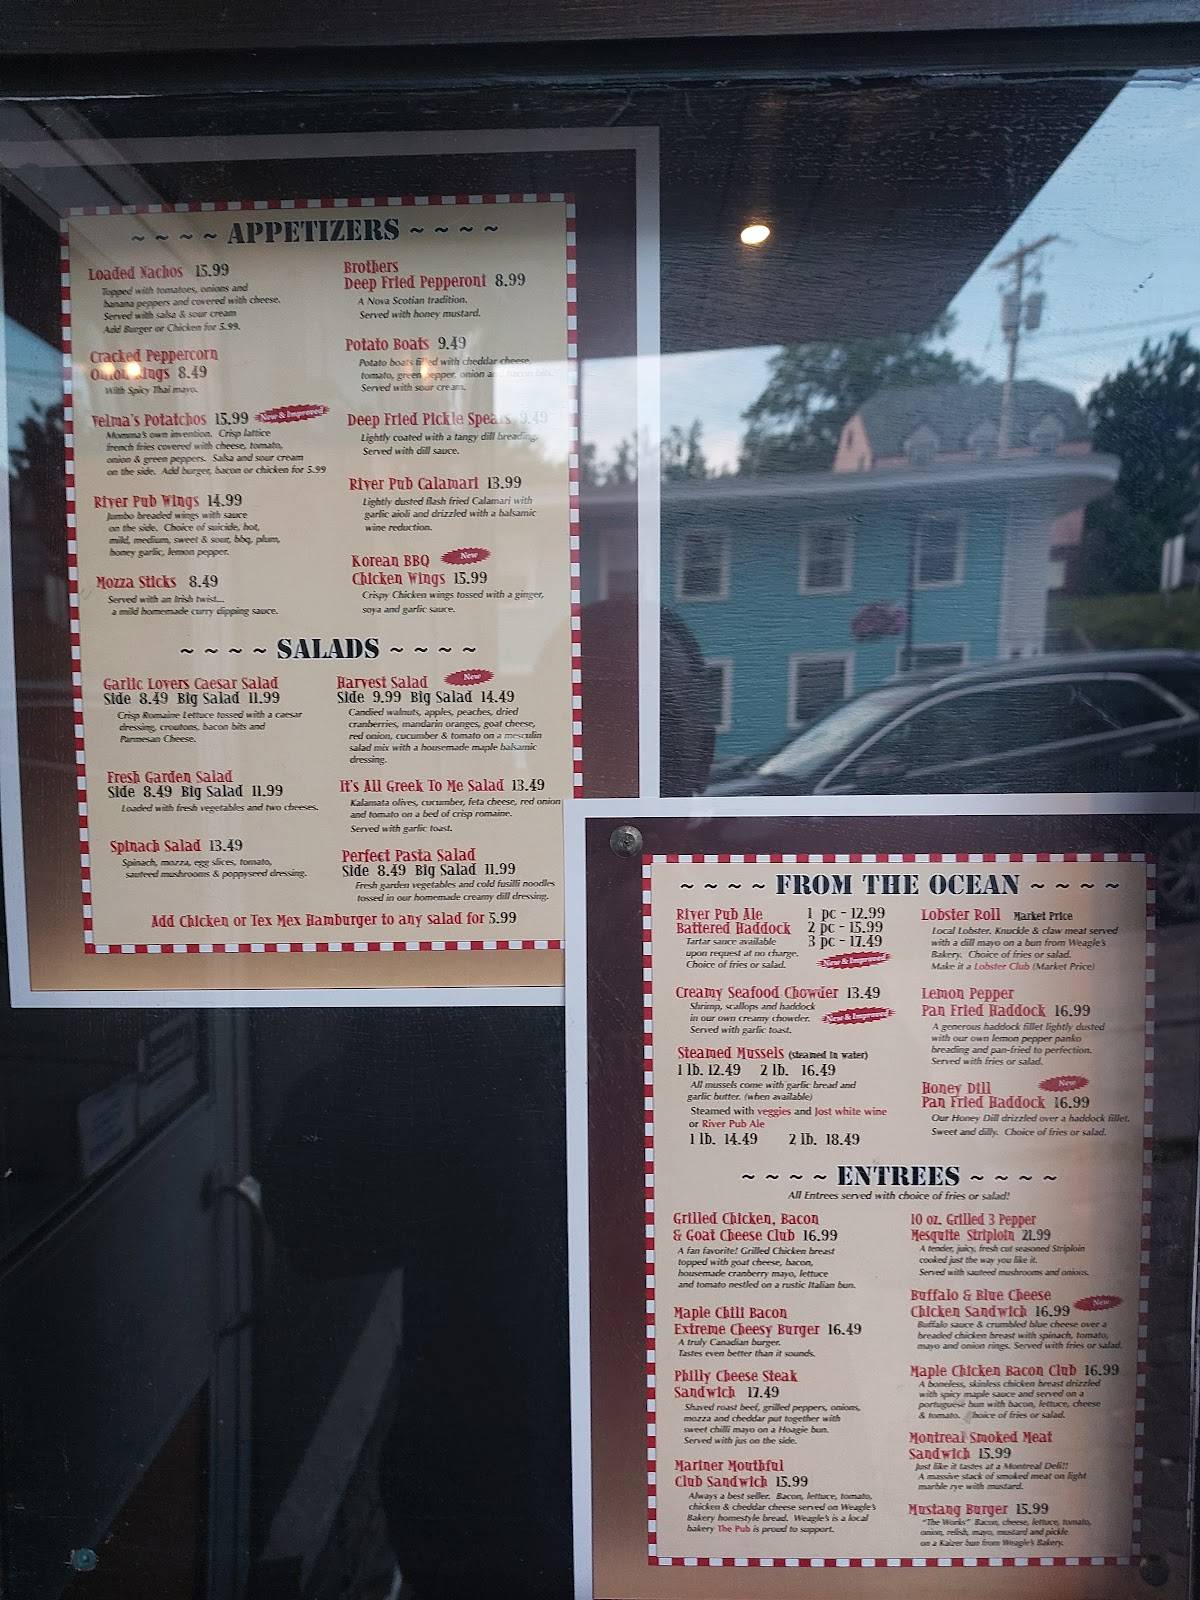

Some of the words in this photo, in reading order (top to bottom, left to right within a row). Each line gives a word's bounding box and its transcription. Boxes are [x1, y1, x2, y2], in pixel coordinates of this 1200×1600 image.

[226, 219, 399, 244] APPETIZERS
[88, 267, 135, 280] Loaded
[140, 266, 183, 279] Nachos
[196, 264, 229, 277] 15.99
[344, 260, 398, 274] Brothers
[344, 277, 377, 292] Deep
[381, 275, 415, 289] Fried
[420, 275, 486, 291] Pepperoni
[495, 273, 525, 287] 8.99
[358, 297, 364, 305] A
[367, 297, 390, 305] Nova
[393, 296, 424, 304] Scotian
[428, 295, 467, 304] tradition.
[360, 310, 389, 319] Served
[392, 309, 411, 318] with
[413, 310, 441, 320] honey
[443, 309, 480, 318] mustard.
[346, 338, 389, 351] Potato
[393, 337, 429, 350] Boats
[438, 336, 466, 350] 9.49
[350, 478, 384, 490] River
[388, 477, 413, 490] Pub
[417, 476, 478, 490] Calamari
[488, 476, 521, 489] 13.99
[94, 496, 128, 509] River
[133, 495, 157, 508] Pub
[162, 494, 199, 510] Wings
[208, 494, 242, 507] 14.99
[352, 555, 399, 567] Korean
[403, 555, 430, 567] BBQ
[96, 577, 135, 589] Mozza
[139, 575, 176, 588] Sticks
[189, 575, 218, 588] 8.49
[352, 572, 403, 585] Chicken
[408, 572, 445, 586] Wings
[454, 572, 487, 584] 15.99
[278, 638, 379, 659] SALADS
[103, 677, 143, 690] Garlic
[147, 678, 190, 691] Lovers
[194, 678, 238, 689] Caesar
[241, 676, 278, 689] Salad
[337, 676, 387, 689] Harvest
[391, 676, 427, 689] Salad
[104, 693, 131, 705] Side
[139, 692, 168, 705] 8.49
[177, 692, 198, 707] Big
[203, 692, 240, 704] Salad
[249, 692, 279, 704] 11.99
[338, 691, 364, 703] Side
[373, 691, 401, 703] 9.99
[411, 691, 430, 706] Big
[436, 690, 472, 703] Salad
[481, 690, 514, 703] 14.49
[340, 780, 359, 792] It's
[364, 779, 381, 792] All
[387, 780, 423, 792] Greek
[429, 779, 442, 791] To
[447, 780, 464, 792] Me
[468, 779, 504, 792] Salad
[512, 779, 544, 791] 13.49
[351, 824, 380, 832] Served
[382, 824, 401, 832] with
[402, 824, 427, 834] garlic
[776, 875, 852, 894] FROM
[863, 875, 919, 894] THE
[929, 875, 1019, 894] OCEAN
[152, 915, 174, 927] Add
[180, 915, 229, 928] Chicken
[233, 917, 247, 926] or
[251, 914, 272, 926] Tex
[277, 915, 300, 927] Mex
[306, 914, 377, 928] Hamburger
[381, 914, 394, 925] to
[399, 915, 422, 927] any
[427, 912, 462, 924] salad
[467, 912, 485, 924] for
[489, 912, 516, 924] 5.99
[921, 909, 970, 920] Lobster
[974, 908, 1000, 920] Roll
[1014, 911, 1046, 921] Market
[1049, 912, 1073, 920] Price
[676, 987, 722, 1001] Creamy
[728, 986, 780, 999] Seafood
[784, 986, 839, 999] Chowder
[848, 987, 880, 999] 13.49
[678, 1047, 731, 1059] Steamed
[737, 1047, 784, 1059] Mussels
[690, 1080, 703, 1089] All
[705, 1080, 737, 1088] mussels
[766, 1080, 784, 1088] with
[786, 1081, 810, 1090] garlic
[691, 1107, 731, 1115] Steamed
[734, 1106, 754, 1115] with
[756, 1107, 792, 1118] veggies
[794, 1106, 812, 1115] and
[835, 1107, 861, 1115] white
[864, 1107, 887, 1115] wine
[837, 1166, 959, 1186] ENTREES
[788, 1191, 802, 1199] All
[805, 1191, 839, 1199] Entrees
[842, 1191, 872, 1199] served
[875, 1191, 895, 1199] with
[898, 1191, 930, 1200] choice
[932, 1191, 944, 1200] of
[945, 1191, 966, 1200] fries
[968, 1192, 979, 1200] or
[982, 1191, 1010, 1200] salad!
[673, 1212, 717, 1224] Grilled
[722, 1212, 775, 1225] Chicken,
[781, 1214, 819, 1225] Bacon
[673, 1230, 682, 1241] &
[686, 1229, 715, 1241] Goat
[720, 1229, 762, 1241] Cheese
[767, 1229, 795, 1241] Club
[803, 1230, 837, 1241] 16.99
[674, 1307, 710, 1321] Maple
[715, 1306, 744, 1319] Chili
[750, 1307, 787, 1319] Bacon
[674, 1324, 726, 1335] Extreme
[730, 1324, 772, 1338] Cheesy
[777, 1324, 819, 1338] Burger
[829, 1323, 861, 1335] 16.49
[674, 1370, 711, 1384] Philly
[716, 1370, 758, 1382] Cheese
[763, 1370, 797, 1382] Steak
[911, 1365, 947, 1379] Maple
[951, 1365, 1001, 1377] Chicken
[1006, 1366, 1043, 1376] Bacon
[1049, 1364, 1077, 1376] Club
[1085, 1364, 1119, 1376] 16.99
[674, 1386, 735, 1398] Sandwich
[748, 1386, 779, 1398] 17.49
[675, 1460, 724, 1472] Mariner
[728, 1459, 783, 1472] Mouthful
[675, 1476, 702, 1487] Club
[707, 1476, 767, 1488] Sandwich
[776, 1476, 808, 1487] 15.99
[909, 1504, 961, 1517] Mustang
[966, 1504, 1008, 1517] Burger
[1016, 1503, 1048, 1514] 15.99
